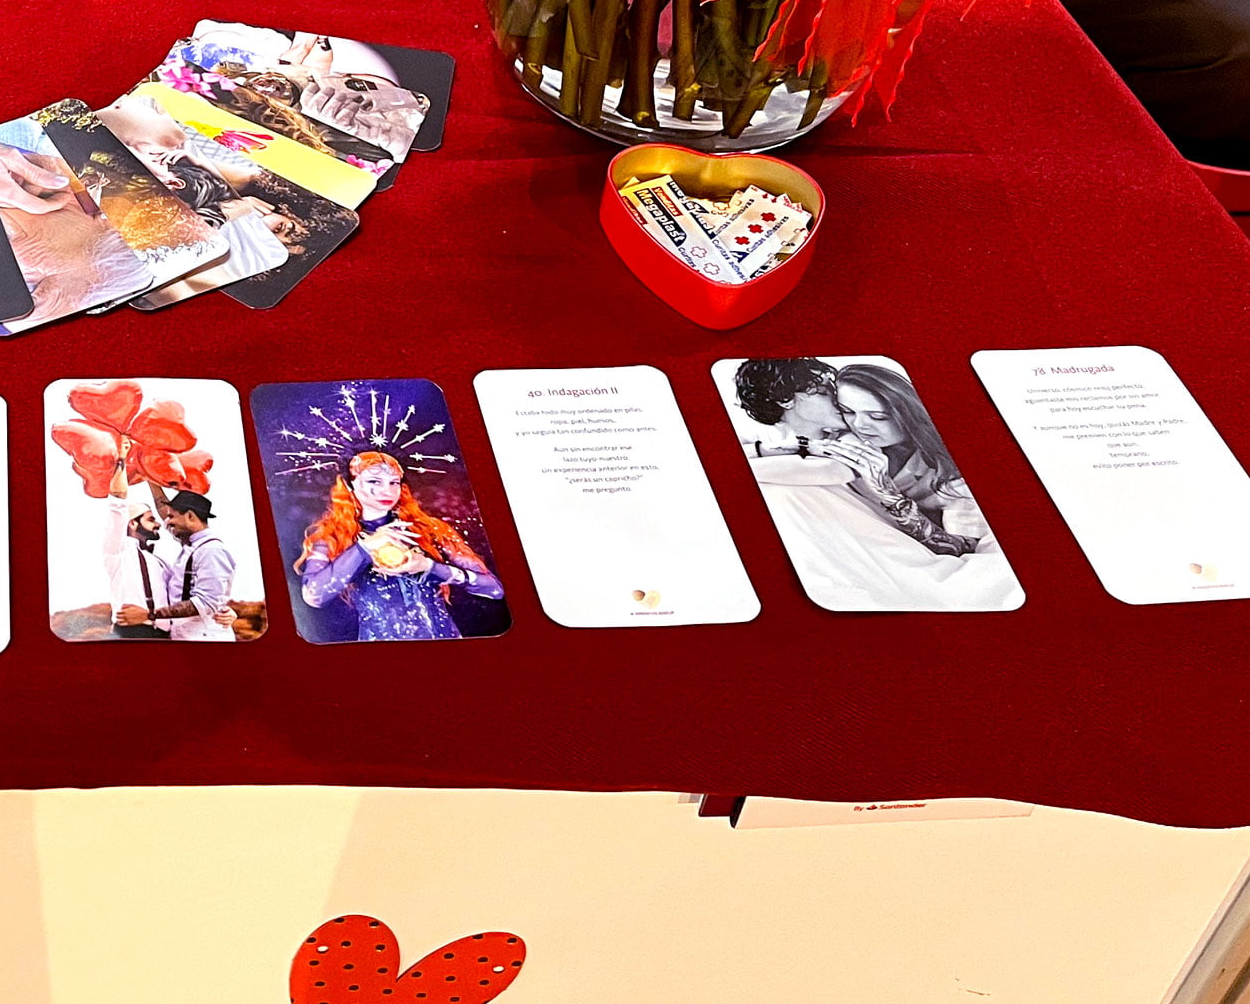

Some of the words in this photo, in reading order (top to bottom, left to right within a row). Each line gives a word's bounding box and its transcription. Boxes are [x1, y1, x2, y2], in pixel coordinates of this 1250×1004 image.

[636, 188, 685, 243] Megaplast
[1050, 364, 1115, 375] Madrugada
[548, 386, 609, 397] Indagación
